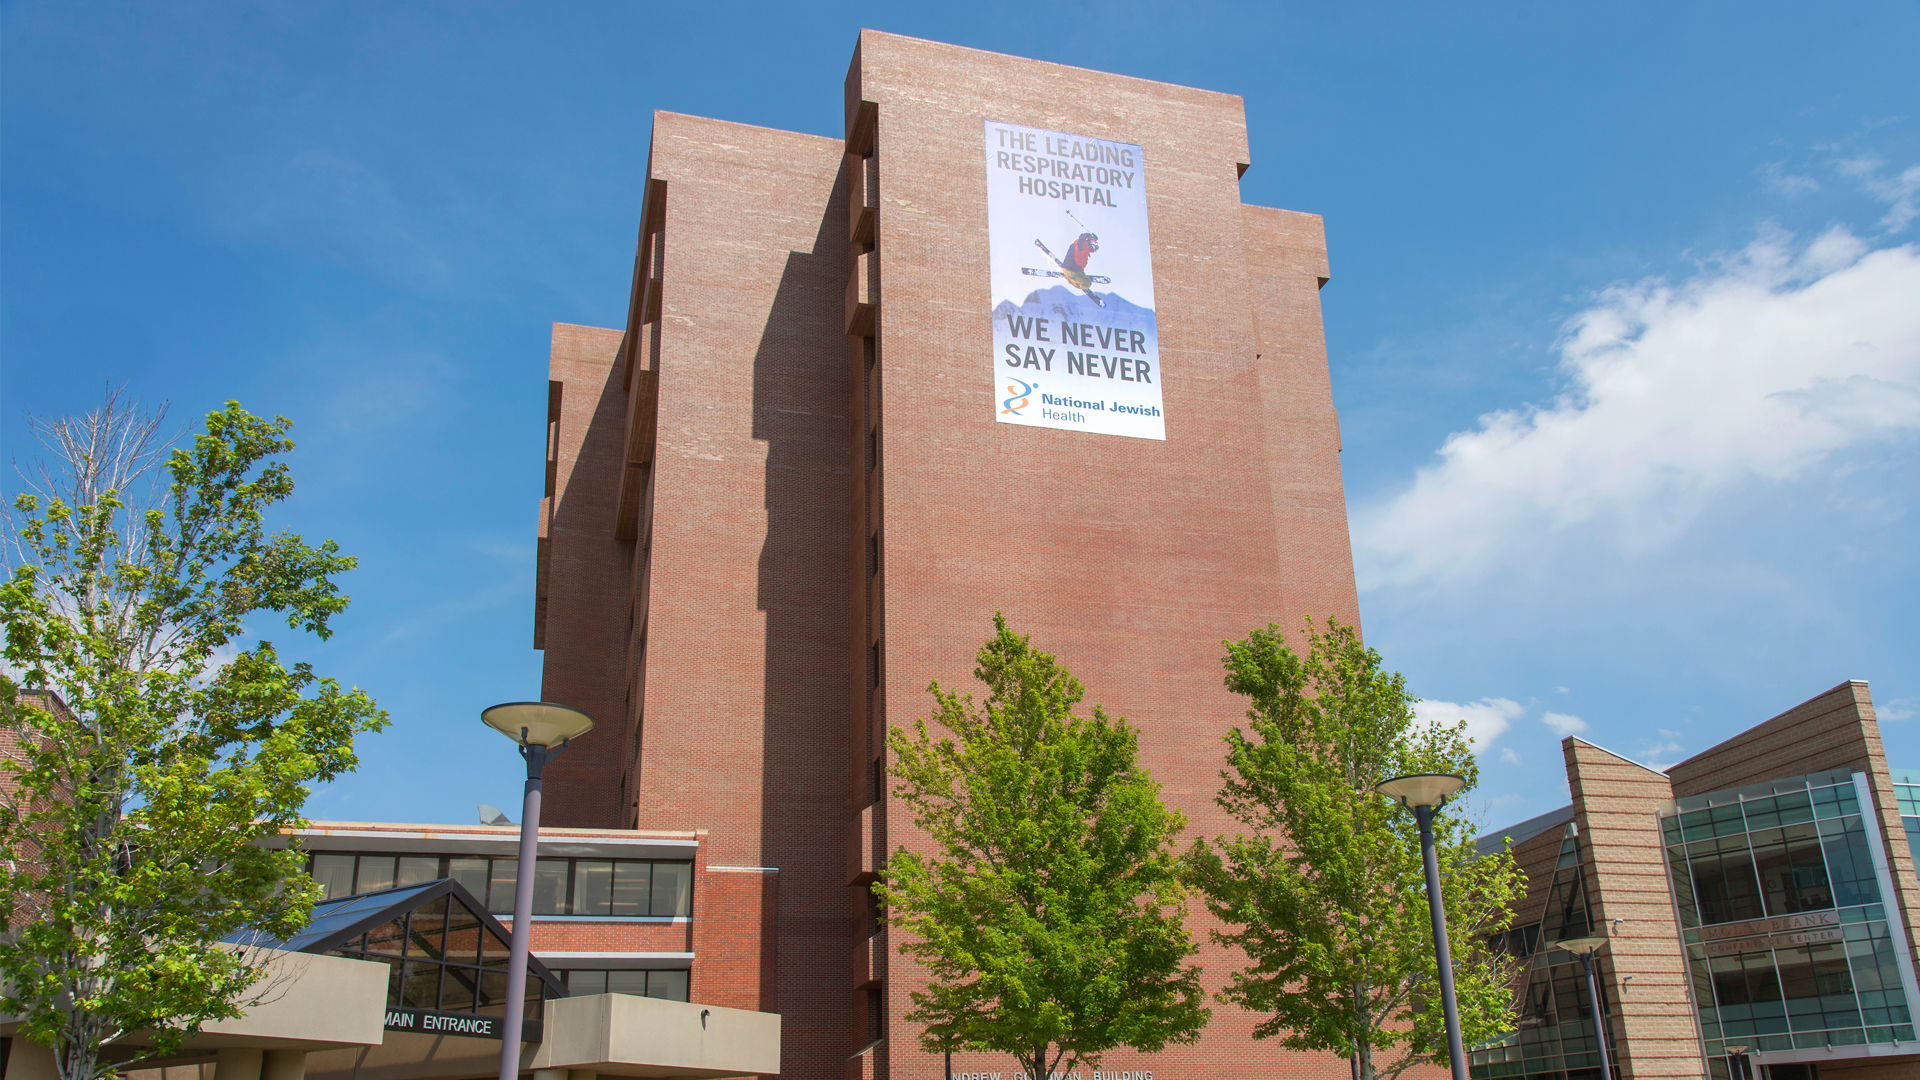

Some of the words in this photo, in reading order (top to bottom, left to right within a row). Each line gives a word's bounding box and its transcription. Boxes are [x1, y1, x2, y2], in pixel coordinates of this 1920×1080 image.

[995, 128, 1037, 152] THE
[1046, 136, 1134, 168] LEADING
[997, 150, 1135, 189] RESPIRATORY
[1018, 175, 1117, 208] HOSPITAL
[1006, 314, 1050, 342] WE
[1061, 321, 1146, 355] NEVER
[1005, 343, 1056, 372] SAY
[1067, 351, 1152, 384] NEVER
[1042, 393, 1105, 411] National
[1109, 401, 1160, 417] Jewish
[1042, 408, 1085, 423] Health
[1708, 922, 1761, 938] MOLLY
[1771, 913, 1830, 930] BLANK
[1711, 937, 1781, 952] CONFERENCE
[1789, 931, 1834, 943] CENTER
[384, 1011, 414, 1028] MAIN
[423, 1015, 492, 1034] ENTRANCE
[944, 1071, 1000, 1080] NDREW
[1093, 1070, 1153, 1080] BUILDING
